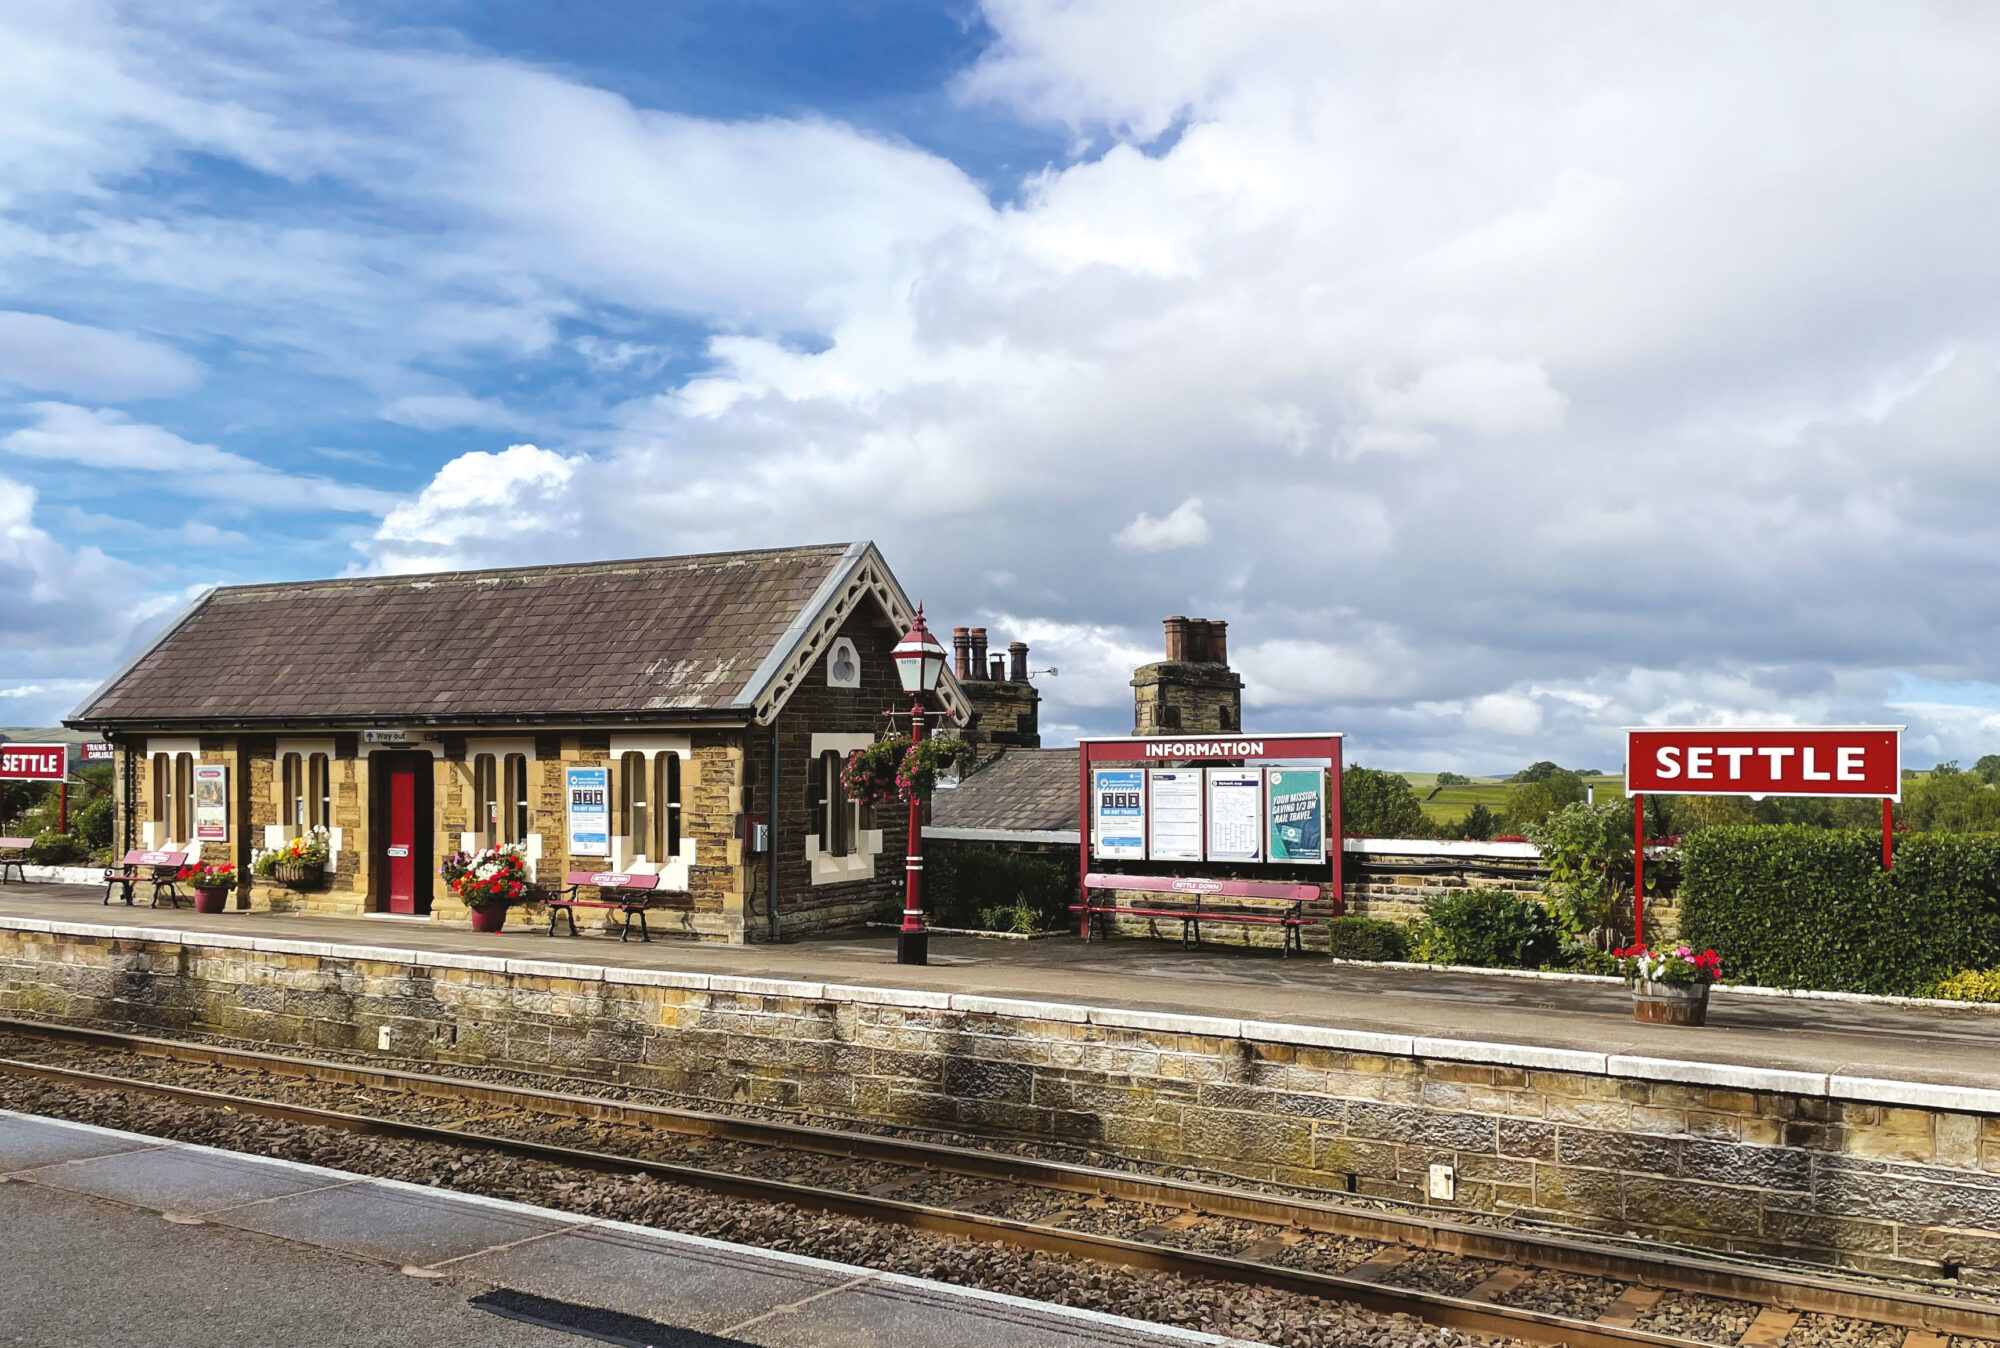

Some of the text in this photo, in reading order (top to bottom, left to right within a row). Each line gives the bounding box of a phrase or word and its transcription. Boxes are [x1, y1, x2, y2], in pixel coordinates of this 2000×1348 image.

[376, 732, 392, 741] Way
[86, 743, 106, 752] TRAINS
[1146, 742, 1264, 757] INFORMATION
[88, 751, 113, 759] CARLISLE
[2, 754, 57, 773] SETTLE
[1655, 746, 1866, 781] SETTLE
[1274, 794, 1290, 805] YOUR
[1272, 800, 1317, 815] SAVING 1/3 ON
[1274, 813, 1288, 824] RAIL
